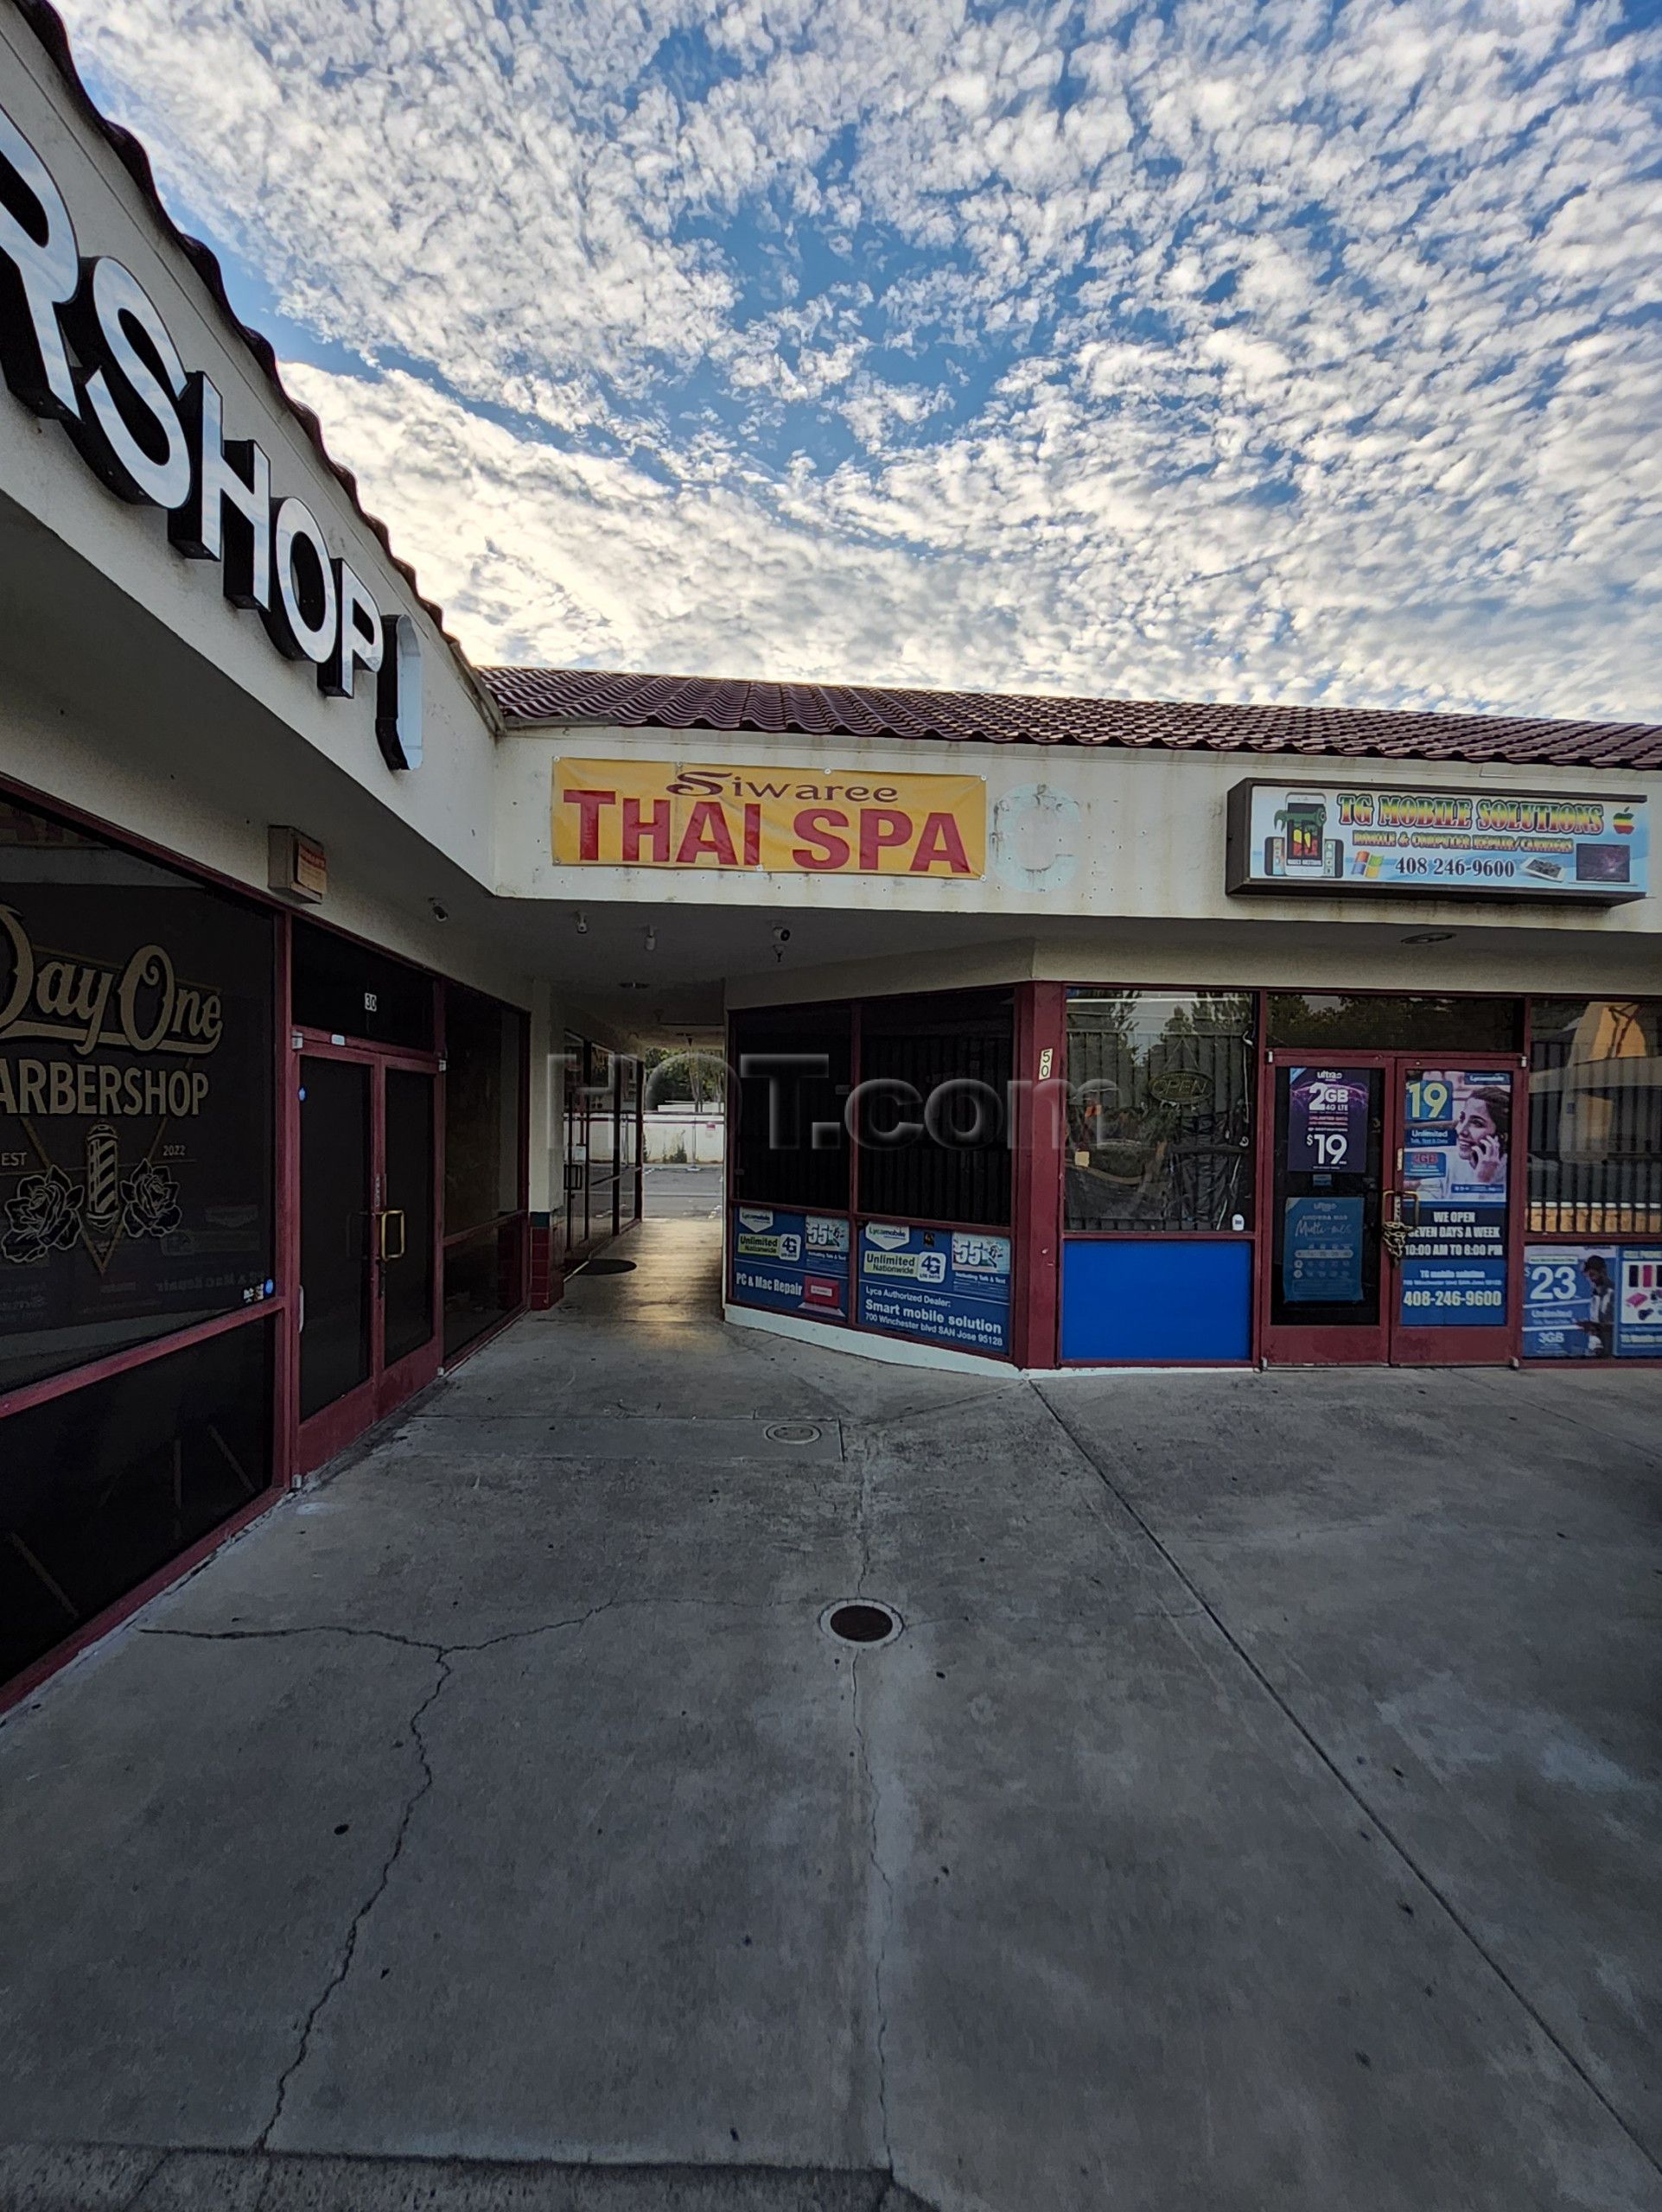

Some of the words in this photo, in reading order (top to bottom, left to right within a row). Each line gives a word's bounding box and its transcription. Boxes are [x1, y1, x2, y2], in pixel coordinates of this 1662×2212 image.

[665, 771, 898, 803] Siwaree
[1337, 793, 1374, 826] TG
[1378, 795, 1471, 830] MOBILE
[1476, 799, 1604, 835] SOLUTIONS
[564, 790, 761, 865] THAI
[793, 808, 971, 874] SPA
[1398, 832, 1410, 848] &
[1396, 857, 1427, 874] 408
[1434, 858, 1514, 877] 246-9600
[118, 943, 224, 1054] One
[366, 995, 377, 1010] 30
[1041, 1049, 1052, 1077] 50
[1152, 1078, 1208, 1096] OPEN
[1309, 1082, 1348, 1110] 2GB
[1411, 1129, 1448, 1138] Unlimited
[162, 1145, 187, 1156] 2022
[1306, 1134, 1348, 1165] $19
[2, 1153, 27, 1166] EST
[1433, 1211, 1449, 1223] WE
[1450, 1211, 1475, 1223] OPEN
[868, 1226, 906, 1237] Lycamobile
[1439, 1227, 1463, 1238] DAYS
[1465, 1227, 1473, 1238] A
[1474, 1227, 1500, 1238] WEEK
[740, 1236, 778, 1247] Unlimited
[781, 1236, 797, 1253] 4G
[1404, 1244, 1431, 1255] 10:00
[1433, 1244, 1448, 1255] AM
[1450, 1244, 1462, 1255] TO
[1487, 1245, 1503, 1255] PM
[867, 1253, 915, 1267] Unlimited
[873, 1264, 914, 1274] Nationwide
[921, 1255, 940, 1274] 4G
[735, 1272, 747, 1286] PC
[748, 1276, 755, 1287] &
[755, 1275, 773, 1291] Mac
[774, 1279, 803, 1296] Repair
[1524, 1266, 1577, 1300] $23
[866, 1286, 882, 1296] Lyca
[883, 1287, 922, 1303] Authorized
[923, 1294, 952, 1307] Dealer:
[1404, 1290, 1502, 1306] 408-246-9600
[865, 1299, 901, 1315] Smart
[903, 1306, 945, 1323] mobile
[948, 1315, 1002, 1334] solution
[865, 1313, 878, 1322] 700
[878, 1314, 919, 1330] Winchester
[920, 1323, 938, 1333] blvd
[938, 1326, 956, 1337] SAN
[956, 1330, 977, 1341] Jose
[977, 1334, 1003, 1346] 95128
